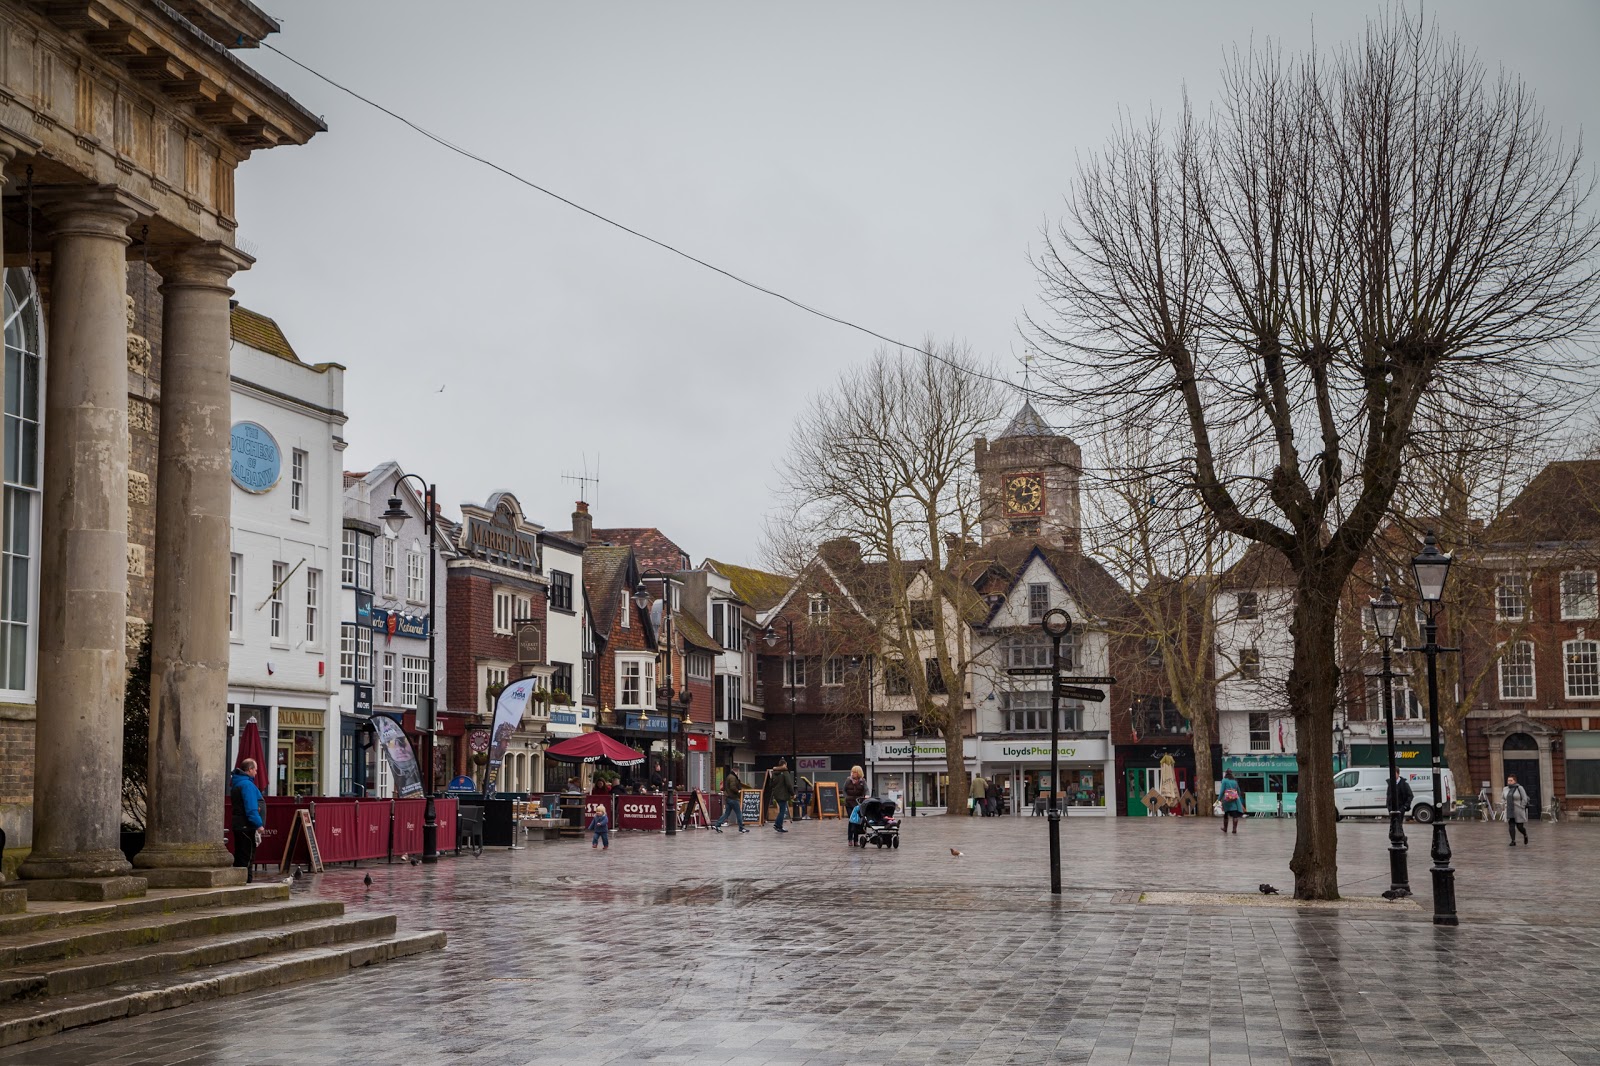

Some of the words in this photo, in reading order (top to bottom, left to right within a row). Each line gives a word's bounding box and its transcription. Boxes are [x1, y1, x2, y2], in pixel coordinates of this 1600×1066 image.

[245, 426, 258, 439] THE
[231, 435, 275, 462] DUCHESS
[247, 457, 257, 469] OF
[231, 461, 272, 487] ALBANY
[471, 522, 514, 554] MARKET
[514, 535, 532, 559] INN
[227, 711, 235, 727] ST
[278, 711, 306, 725] PALOMA
[308, 712, 323, 726] LILY
[885, 745, 945, 755] LloydsPharma
[1394, 751, 1419, 759] UBWAY
[799, 759, 826, 768] GAME
[1232, 760, 1275, 768] Henderson's
[623, 804, 657, 813] COSTA
